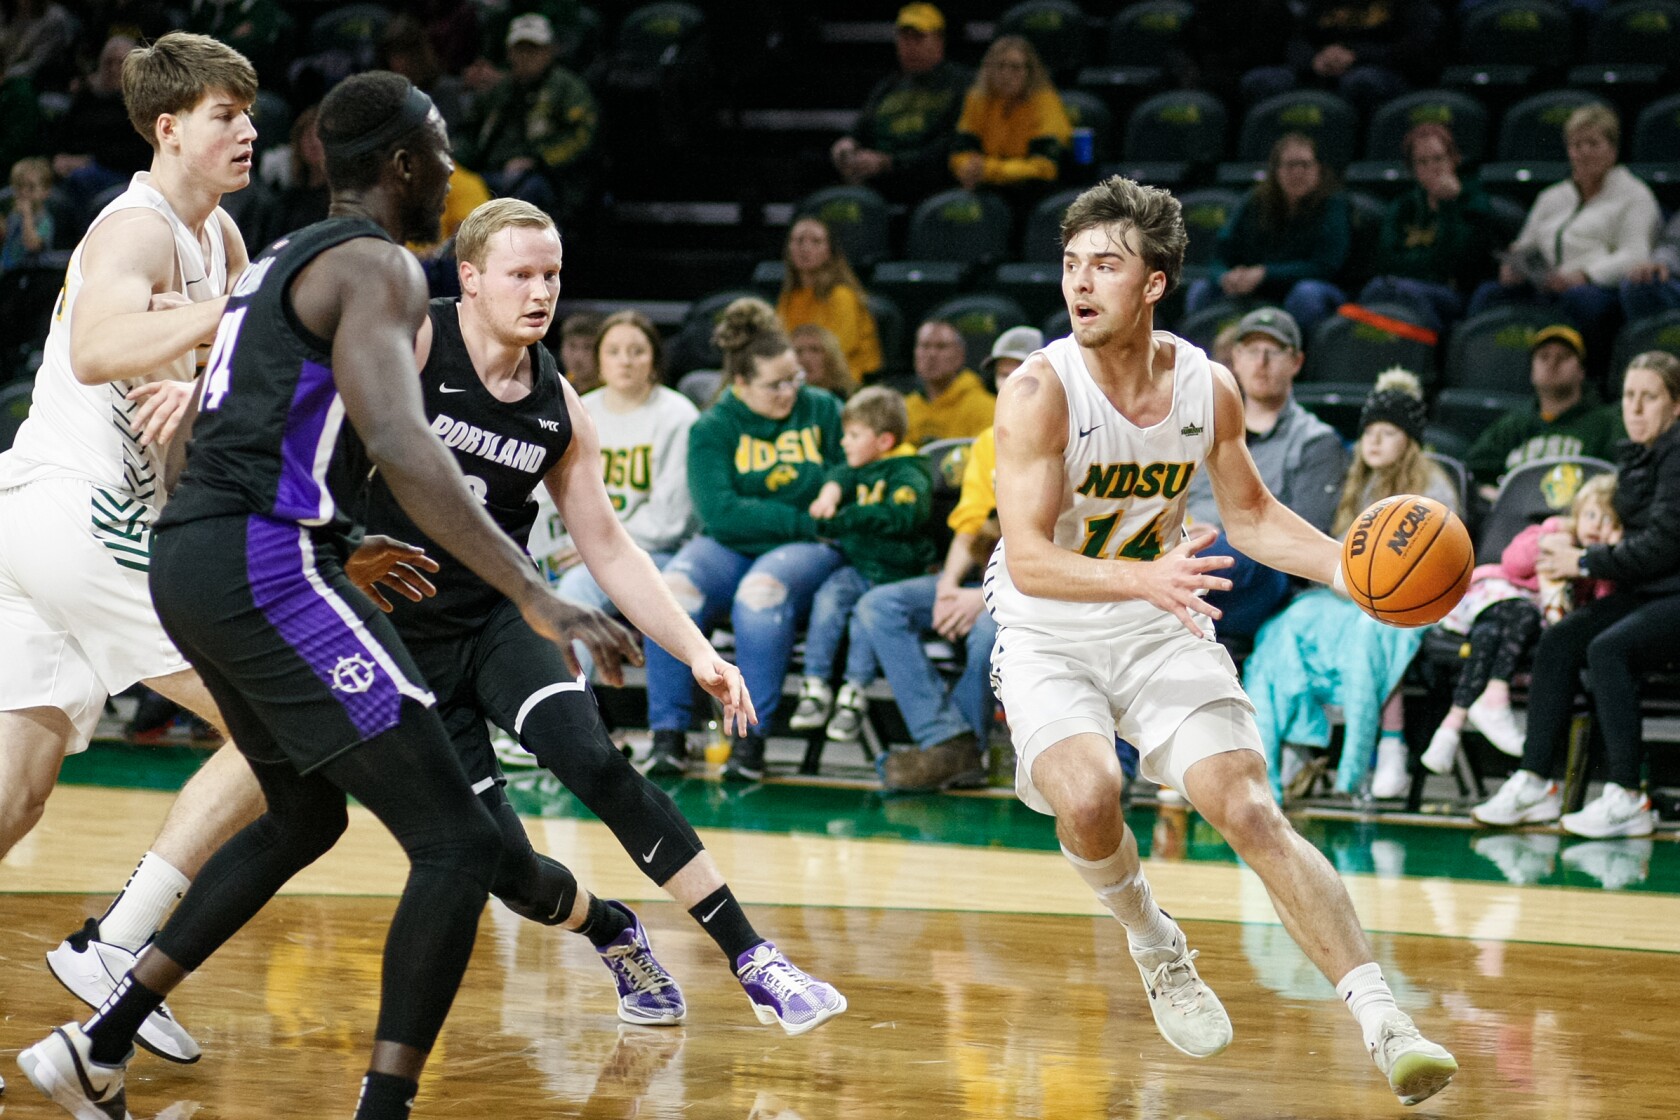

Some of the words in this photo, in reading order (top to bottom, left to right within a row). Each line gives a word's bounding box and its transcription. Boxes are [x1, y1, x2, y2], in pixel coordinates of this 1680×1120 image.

[429, 413, 547, 475] PORTLAND
[538, 418, 560, 433] WCC
[600, 444, 654, 492] DSU
[1073, 461, 1196, 502] NDSU
[1072, 508, 1171, 562] 14
[1386, 502, 1431, 557] NCAA
